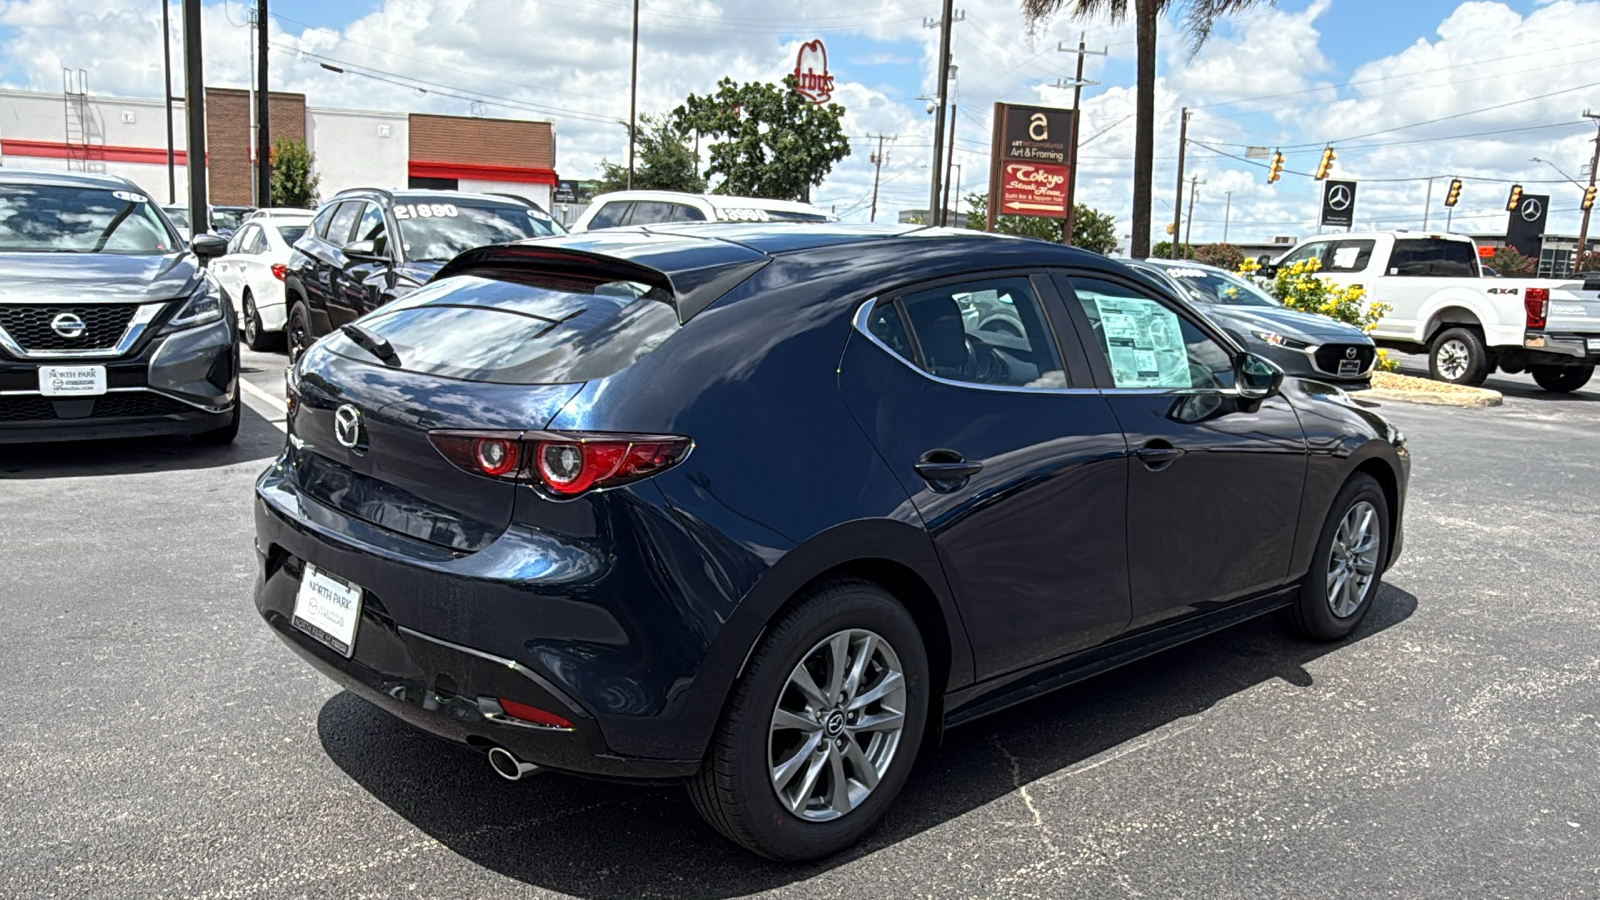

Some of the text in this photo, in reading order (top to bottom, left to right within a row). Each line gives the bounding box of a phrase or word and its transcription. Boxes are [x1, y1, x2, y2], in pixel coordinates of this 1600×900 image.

[1011, 147, 1063, 162] Art & Framing
[1006, 164, 1064, 188] Tokyo
[1005, 181, 1037, 191] Steak
[49, 370, 97, 379] NORTH PARK
[309, 580, 353, 610] NORTH PARK
